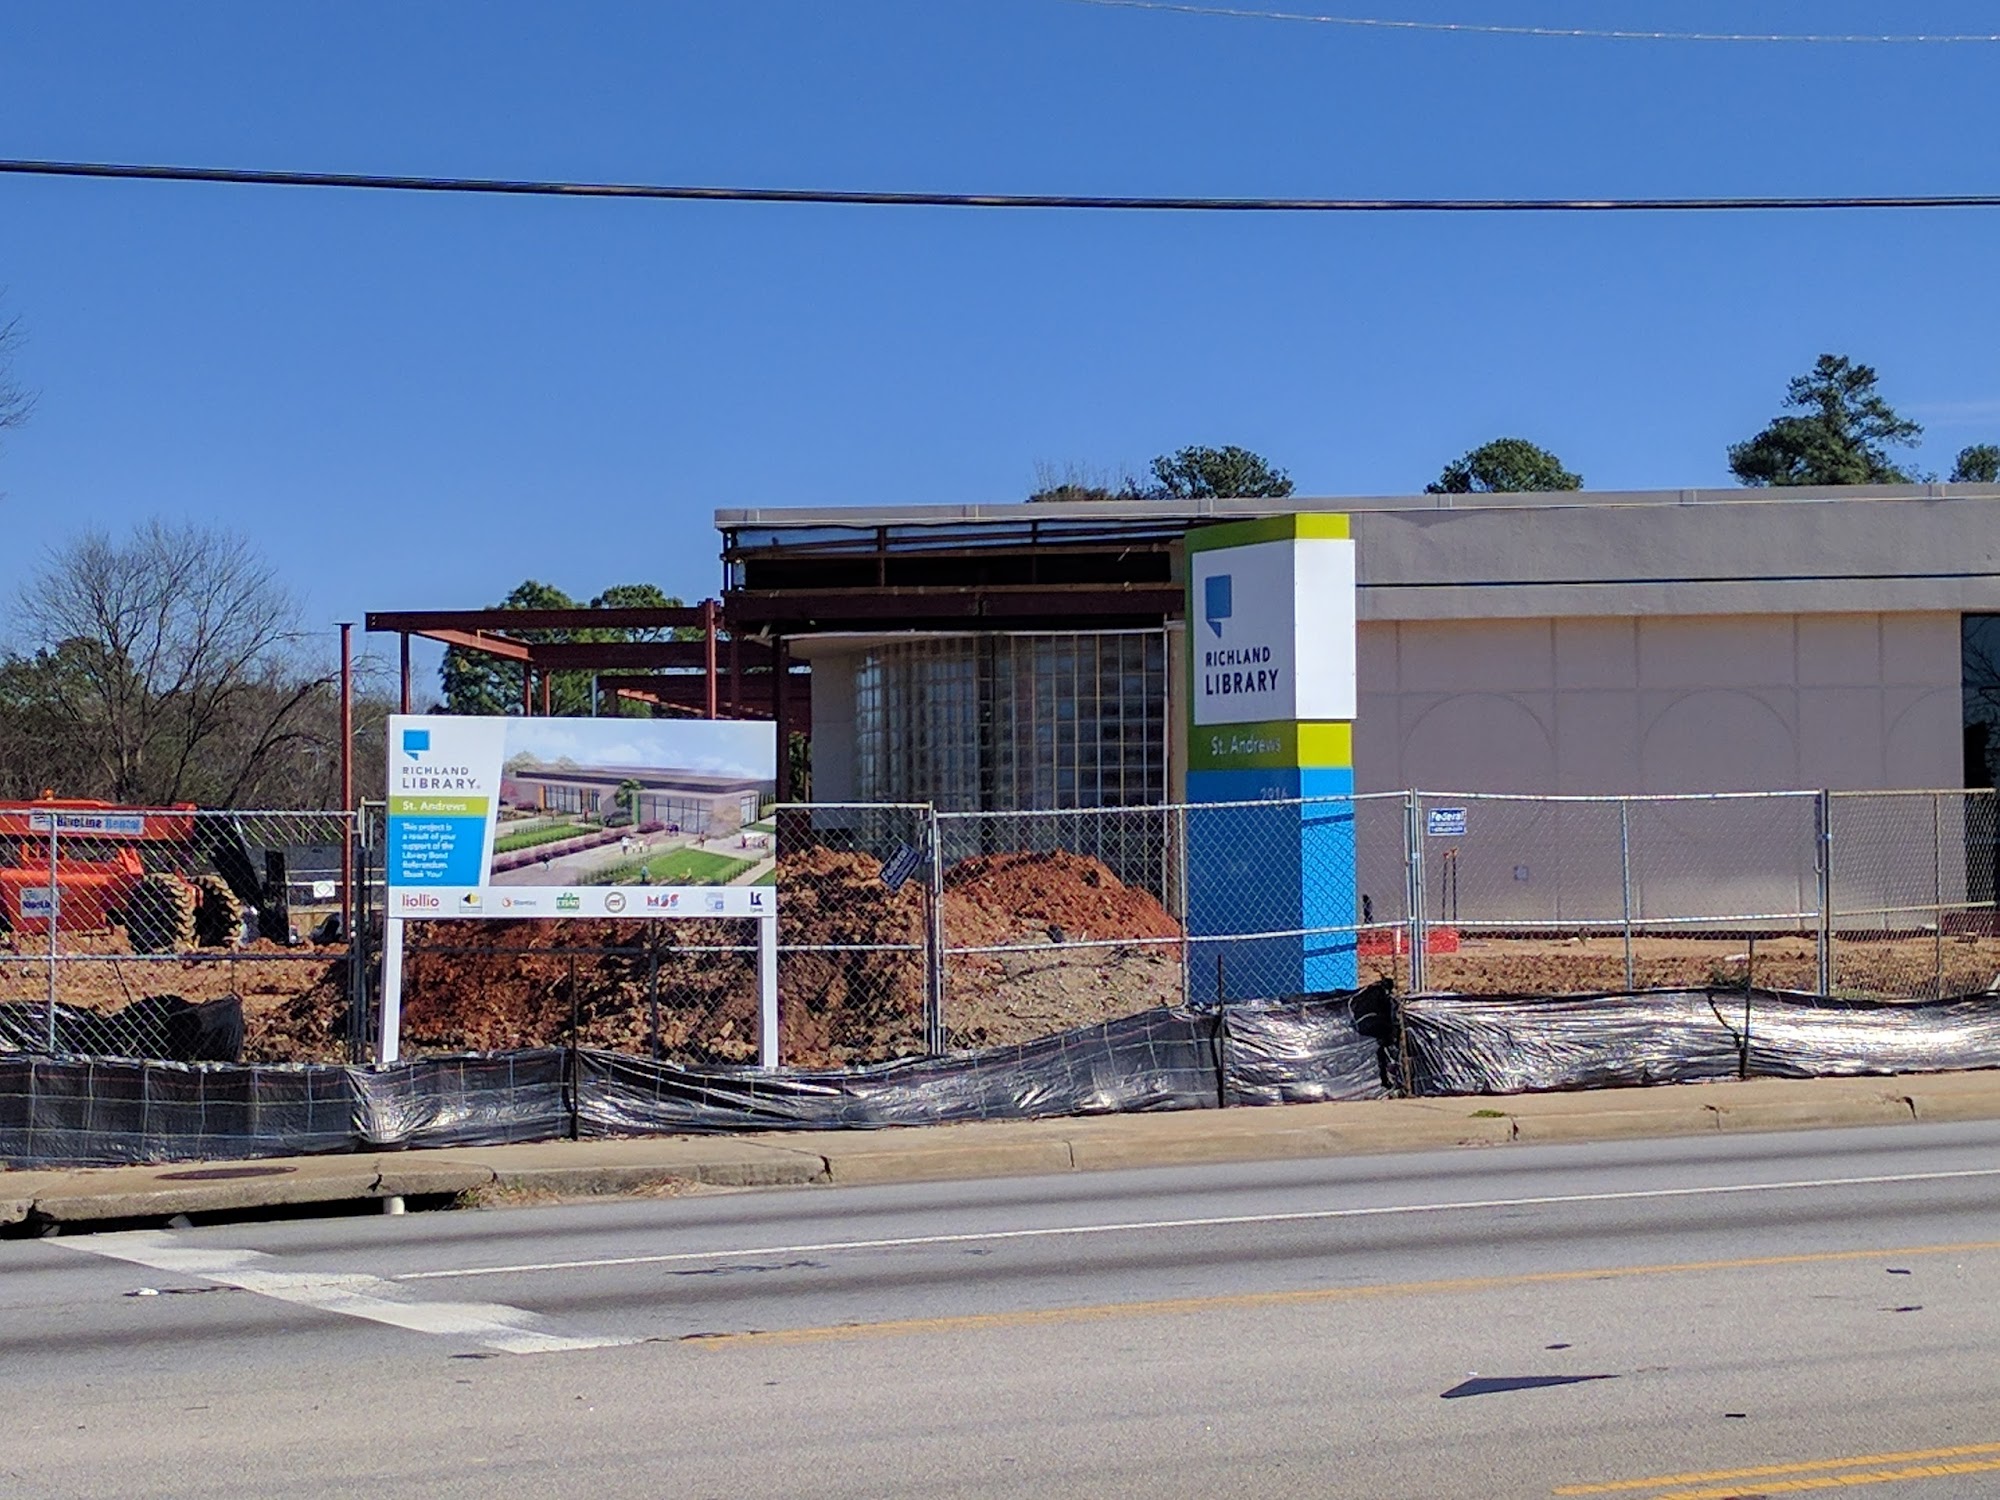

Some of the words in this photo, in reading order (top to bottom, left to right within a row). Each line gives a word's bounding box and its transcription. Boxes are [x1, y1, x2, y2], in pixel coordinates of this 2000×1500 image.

[1206, 647, 1270, 667] RICHLAND
[1206, 669, 1279, 695] LIBRARY
[1211, 736, 1226, 755] St.
[1230, 735, 1281, 753] Andrews
[402, 766, 469, 775] RICHLAND
[402, 801, 417, 811] St.
[420, 801, 466, 811] Andrews
[402, 822, 418, 831] This
[419, 823, 445, 833] project
[446, 823, 453, 832] is
[409, 833, 430, 841] result
[431, 832, 439, 840] of
[440, 834, 456, 843] your
[402, 843, 432, 851] support
[433, 842, 441, 850] of
[442, 842, 454, 850] the
[402, 851, 427, 861] Library
[429, 851, 449, 859] Bond
[402, 893, 439, 907] liollio
